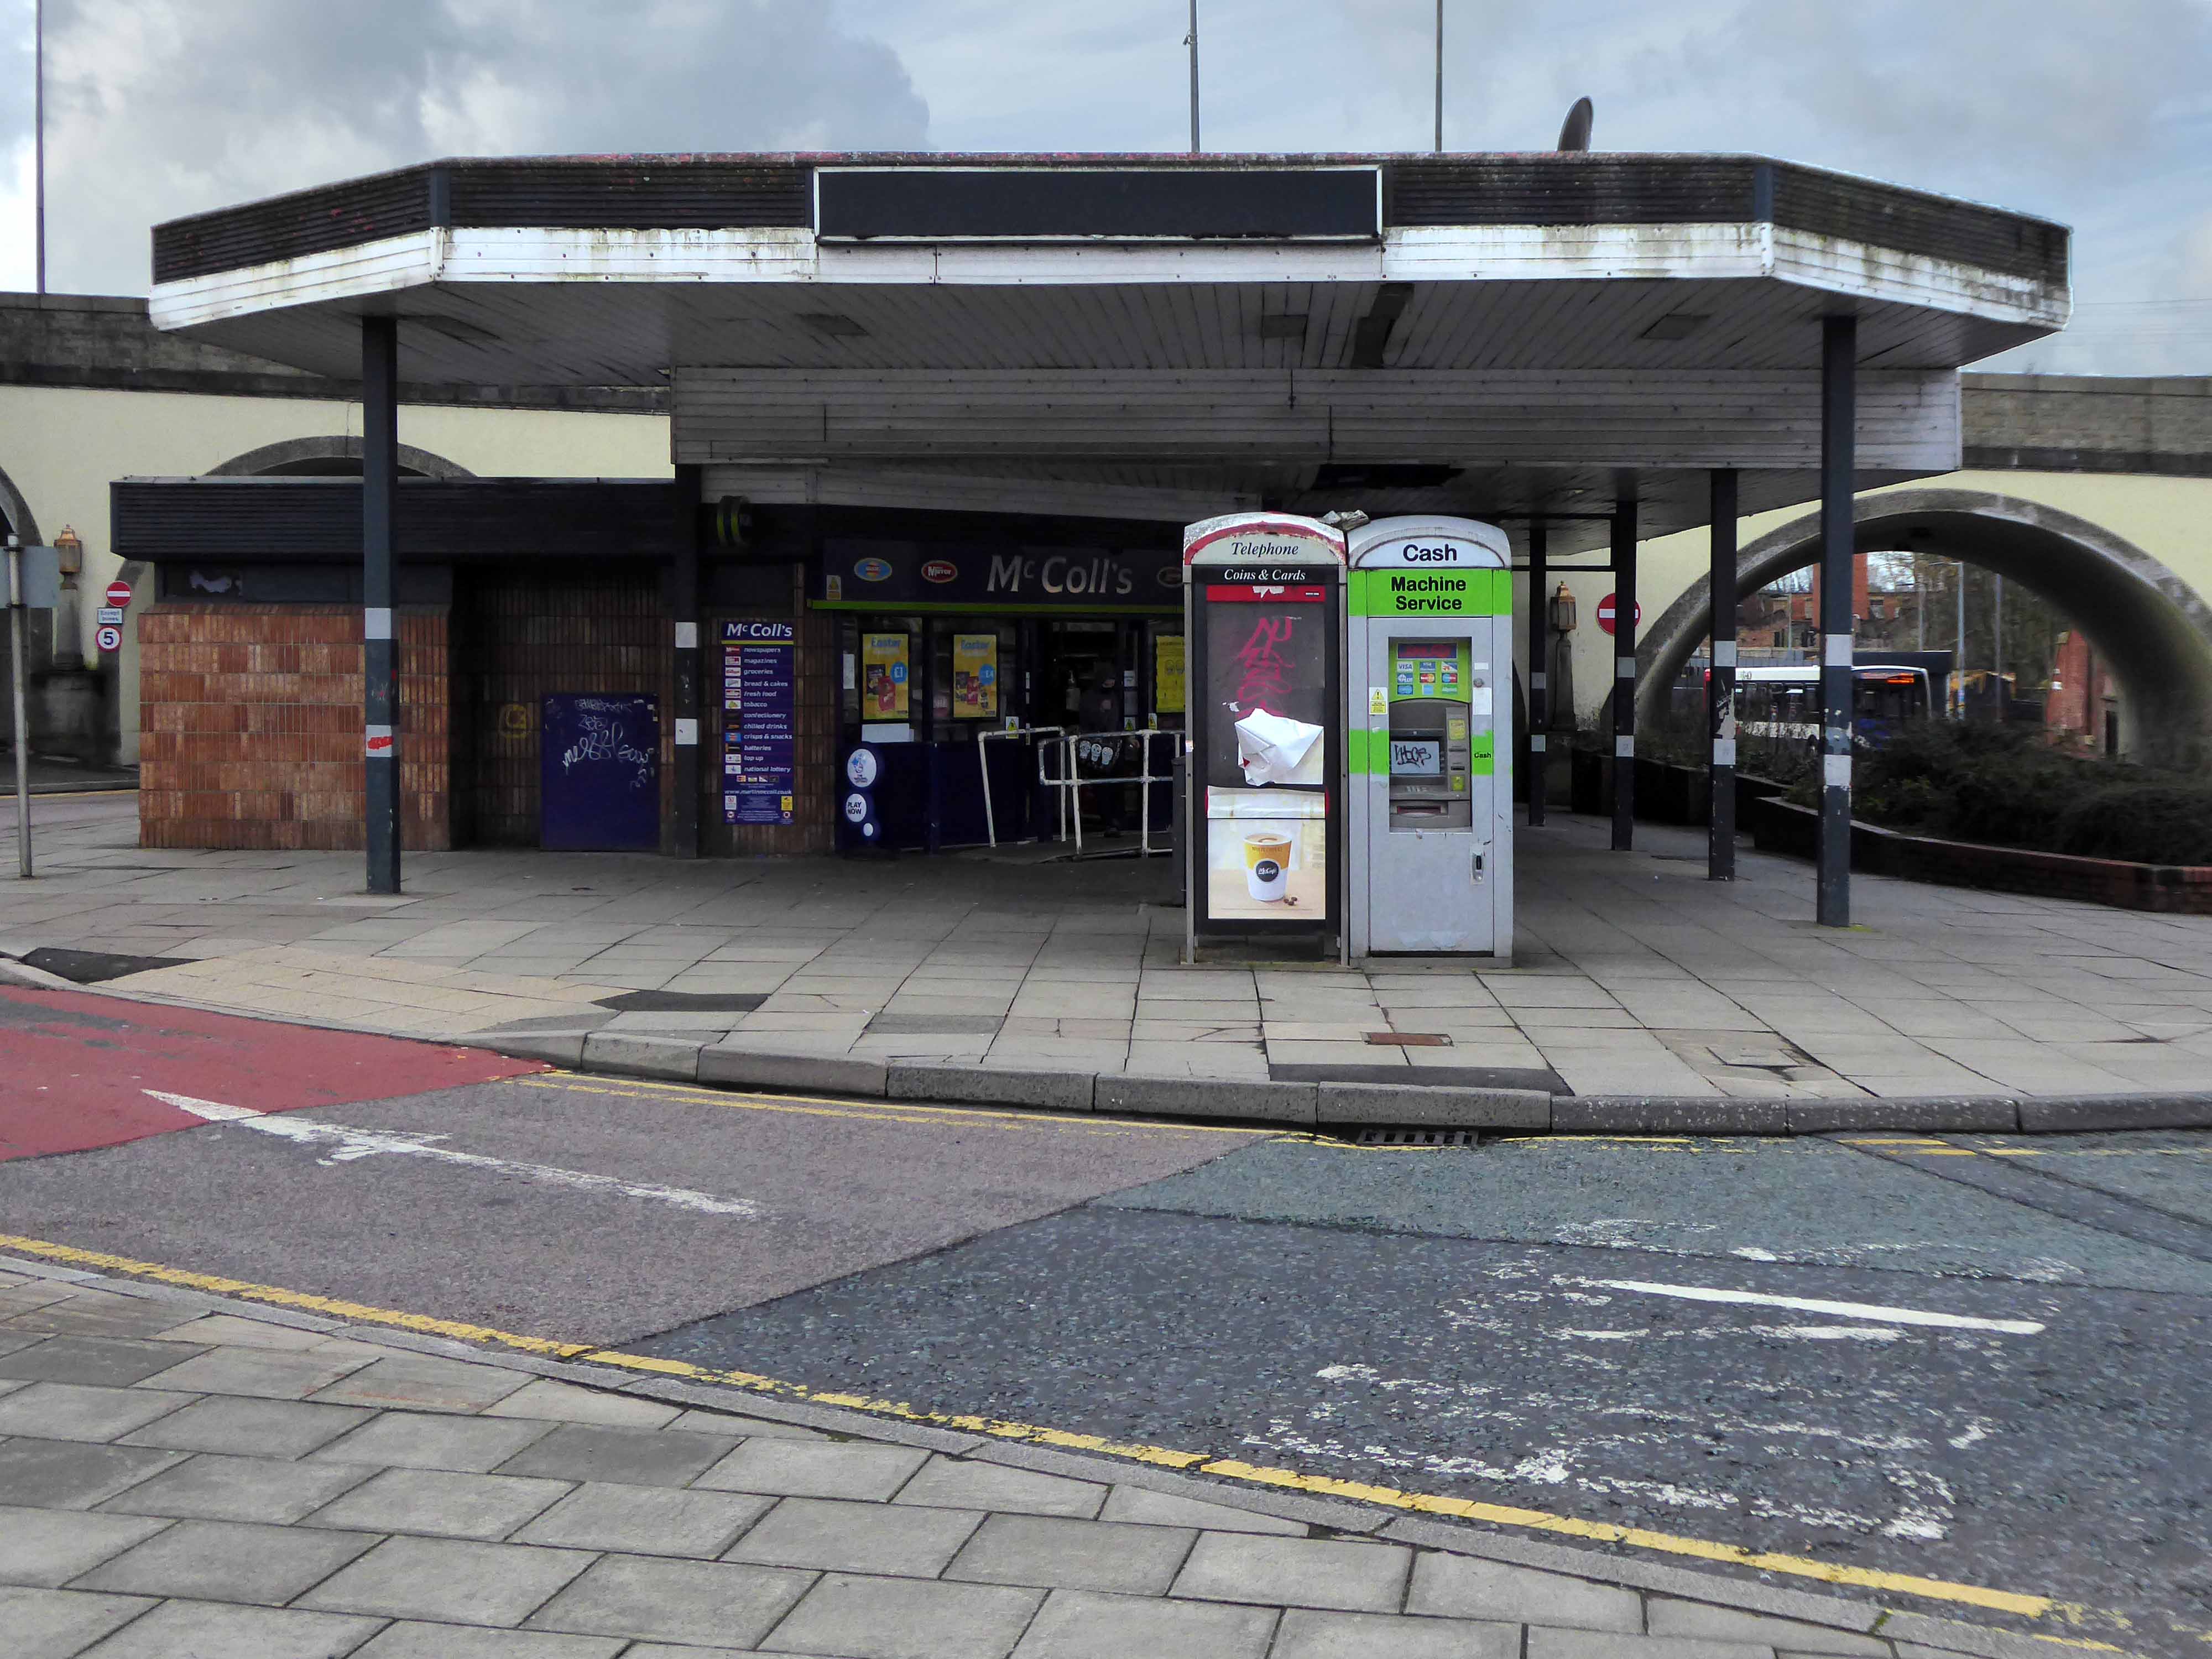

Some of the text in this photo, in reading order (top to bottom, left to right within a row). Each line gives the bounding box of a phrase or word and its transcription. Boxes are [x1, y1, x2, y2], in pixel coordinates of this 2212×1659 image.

[1231, 542, 1299, 558] Telephone
[1403, 544, 1457, 562] Cash
[1224, 568, 1306, 581] Coins & Cards
[1391, 576, 1467, 592] Machine
[1395, 595, 1462, 611] Service
[103, 631, 114, 646] 5
